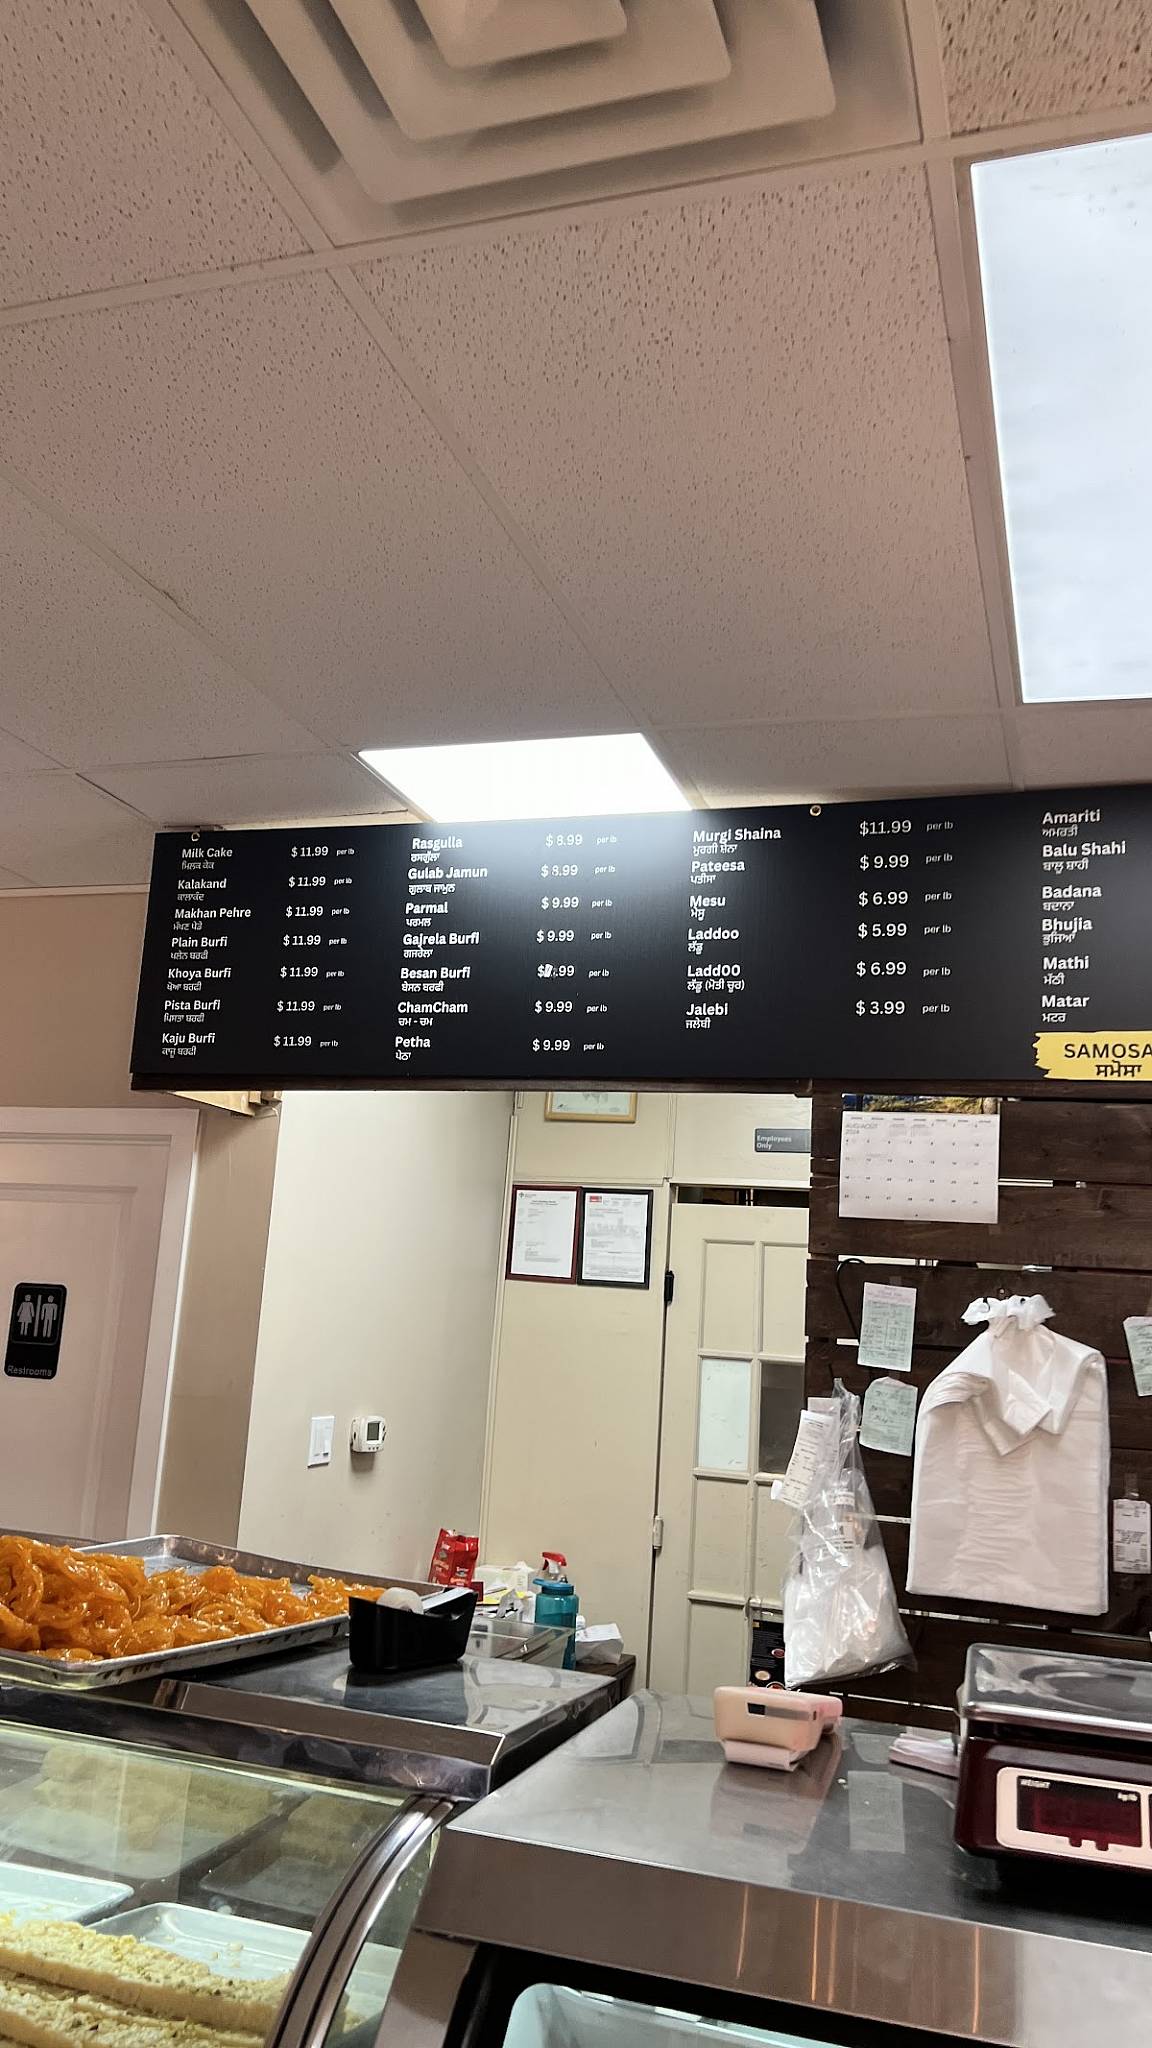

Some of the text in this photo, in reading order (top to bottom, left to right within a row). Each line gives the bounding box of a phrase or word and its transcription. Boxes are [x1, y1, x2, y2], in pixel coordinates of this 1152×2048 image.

[1042, 809, 1101, 824] Amariti
[859, 820, 911, 836] $11.99
[927, 821, 953, 832] per lb
[694, 828, 781, 844] Murgi Shaina
[412, 837, 463, 851] Rasgulla
[1043, 841, 1125, 857] Balu Shahi
[182, 848, 233, 858] Milk Cake
[692, 860, 745, 873] Pateesa
[408, 867, 488, 879] Gulab Jamun
[178, 878, 226, 889] Kalakand
[1042, 885, 1102, 899] Badana
[690, 895, 726, 908] Mesu
[175, 906, 251, 919] Makhan Pehre
[406, 902, 448, 914] Parmal
[1042, 917, 1092, 933] Bhujia
[403, 932, 479, 948] Gajrela Burfi
[688, 928, 739, 940] Laddoo
[172, 936, 228, 947] Plain Burfi
[1043, 956, 1089, 970] Mathi
[168, 968, 231, 980] Khoya Burfi
[401, 966, 471, 979] Besan Burfi
[164, 1000, 220, 1010] Pista Burfi
[1042, 995, 1089, 1007] Matar
[398, 1002, 468, 1013] ChamCham
[686, 1003, 728, 1016] Jalebi
[162, 1033, 215, 1045] Kaju Burfi
[395, 1036, 430, 1048] Petha
[1065, 1043, 1152, 1058] SAMOSA
[757, 1134, 792, 1144] Employees
[757, 1142, 772, 1150] Only
[8, 1365, 52, 1376] Restrooms
